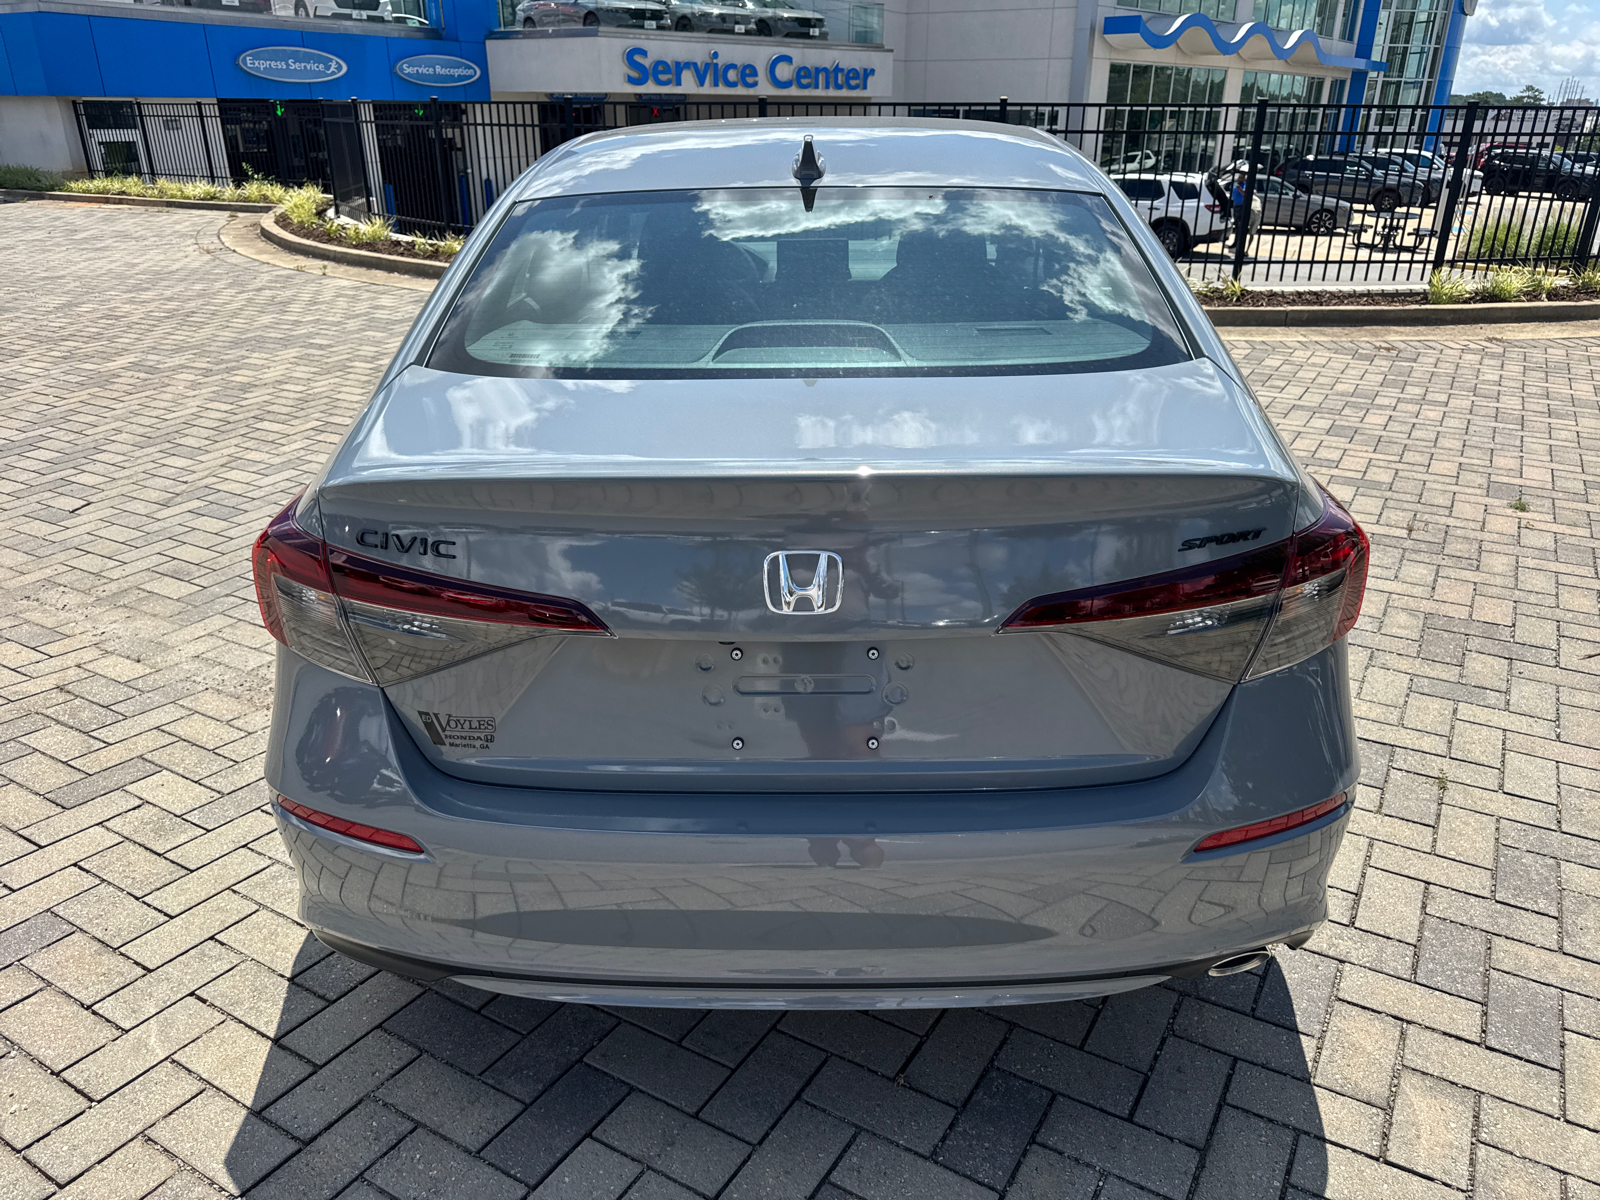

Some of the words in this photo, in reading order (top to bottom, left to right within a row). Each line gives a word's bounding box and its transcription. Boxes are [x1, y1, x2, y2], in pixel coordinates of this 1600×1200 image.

[246, 56, 287, 71] Express
[288, 59, 325, 71] Service
[402, 63, 434, 74] Service
[435, 65, 475, 78] Reception
[625, 47, 759, 89] Service
[767, 53, 876, 91] Center
[356, 528, 457, 559] CIVIC
[1177, 526, 1268, 552] SPORT
[421, 714, 432, 723] ED
[432, 711, 495, 733] VOYLES
[444, 733, 484, 742] HONDA
[448, 741, 479, 750] Marietta,
